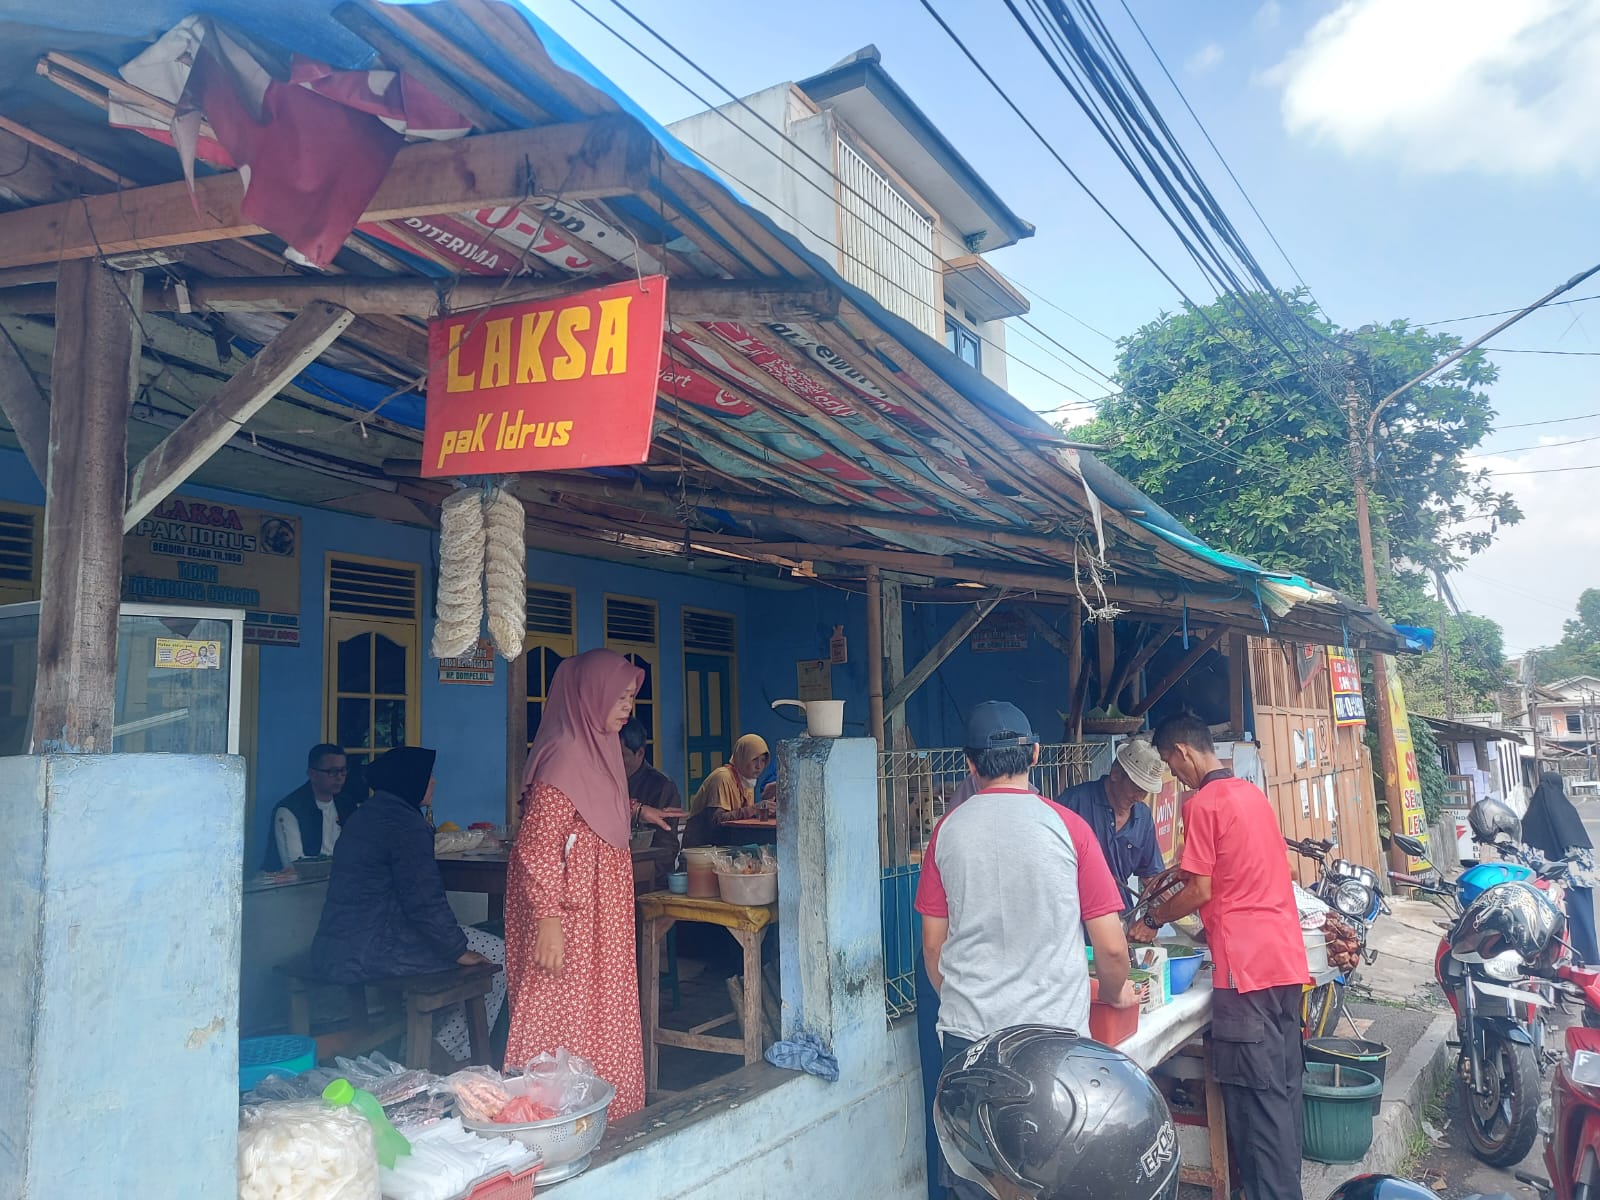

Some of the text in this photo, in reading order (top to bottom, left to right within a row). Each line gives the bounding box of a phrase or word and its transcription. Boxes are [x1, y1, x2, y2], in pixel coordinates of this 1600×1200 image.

[404, 217, 499, 269] DITERIMA
[447, 296, 632, 392] LAKSA
[496, 410, 574, 451] Idrus
[136, 518, 257, 552] PAK IDRUS
[152, 500, 244, 531] LAKSA
